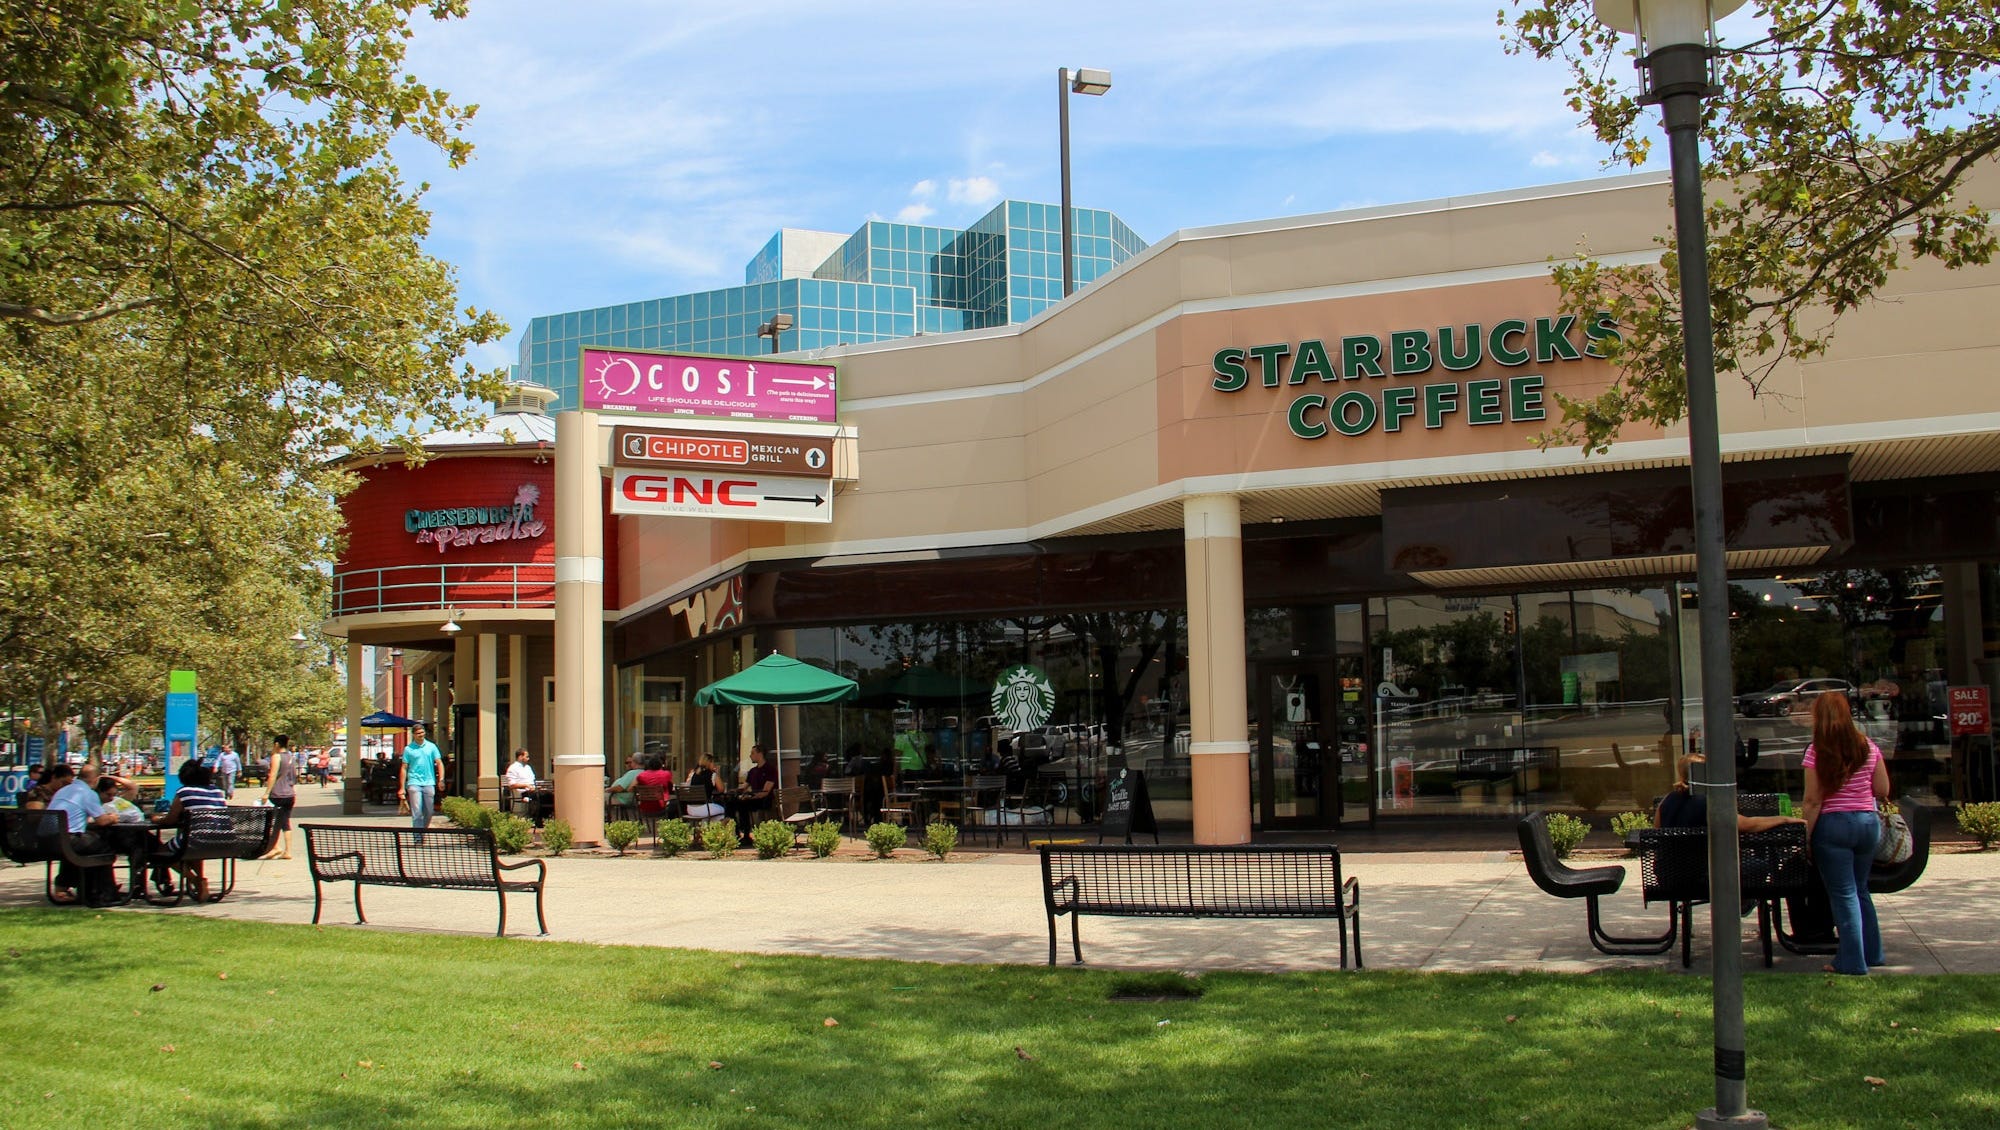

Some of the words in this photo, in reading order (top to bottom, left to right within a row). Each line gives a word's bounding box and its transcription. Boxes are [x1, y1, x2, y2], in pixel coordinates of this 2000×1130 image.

[1212, 311, 1623, 392] STARBUCKS
[649, 364, 758, 397] COSÌ
[666, 397, 700, 405] SHOULD
[1287, 375, 1546, 439] COFFEE
[652, 440, 743, 460] CHIPOTLE
[751, 444, 800, 455] MEXICAN
[751, 453, 783, 463] GRILL
[622, 475, 758, 507] GNC
[405, 504, 534, 533] CHEESEBURGER
[1953, 689, 1979, 700] SALE
